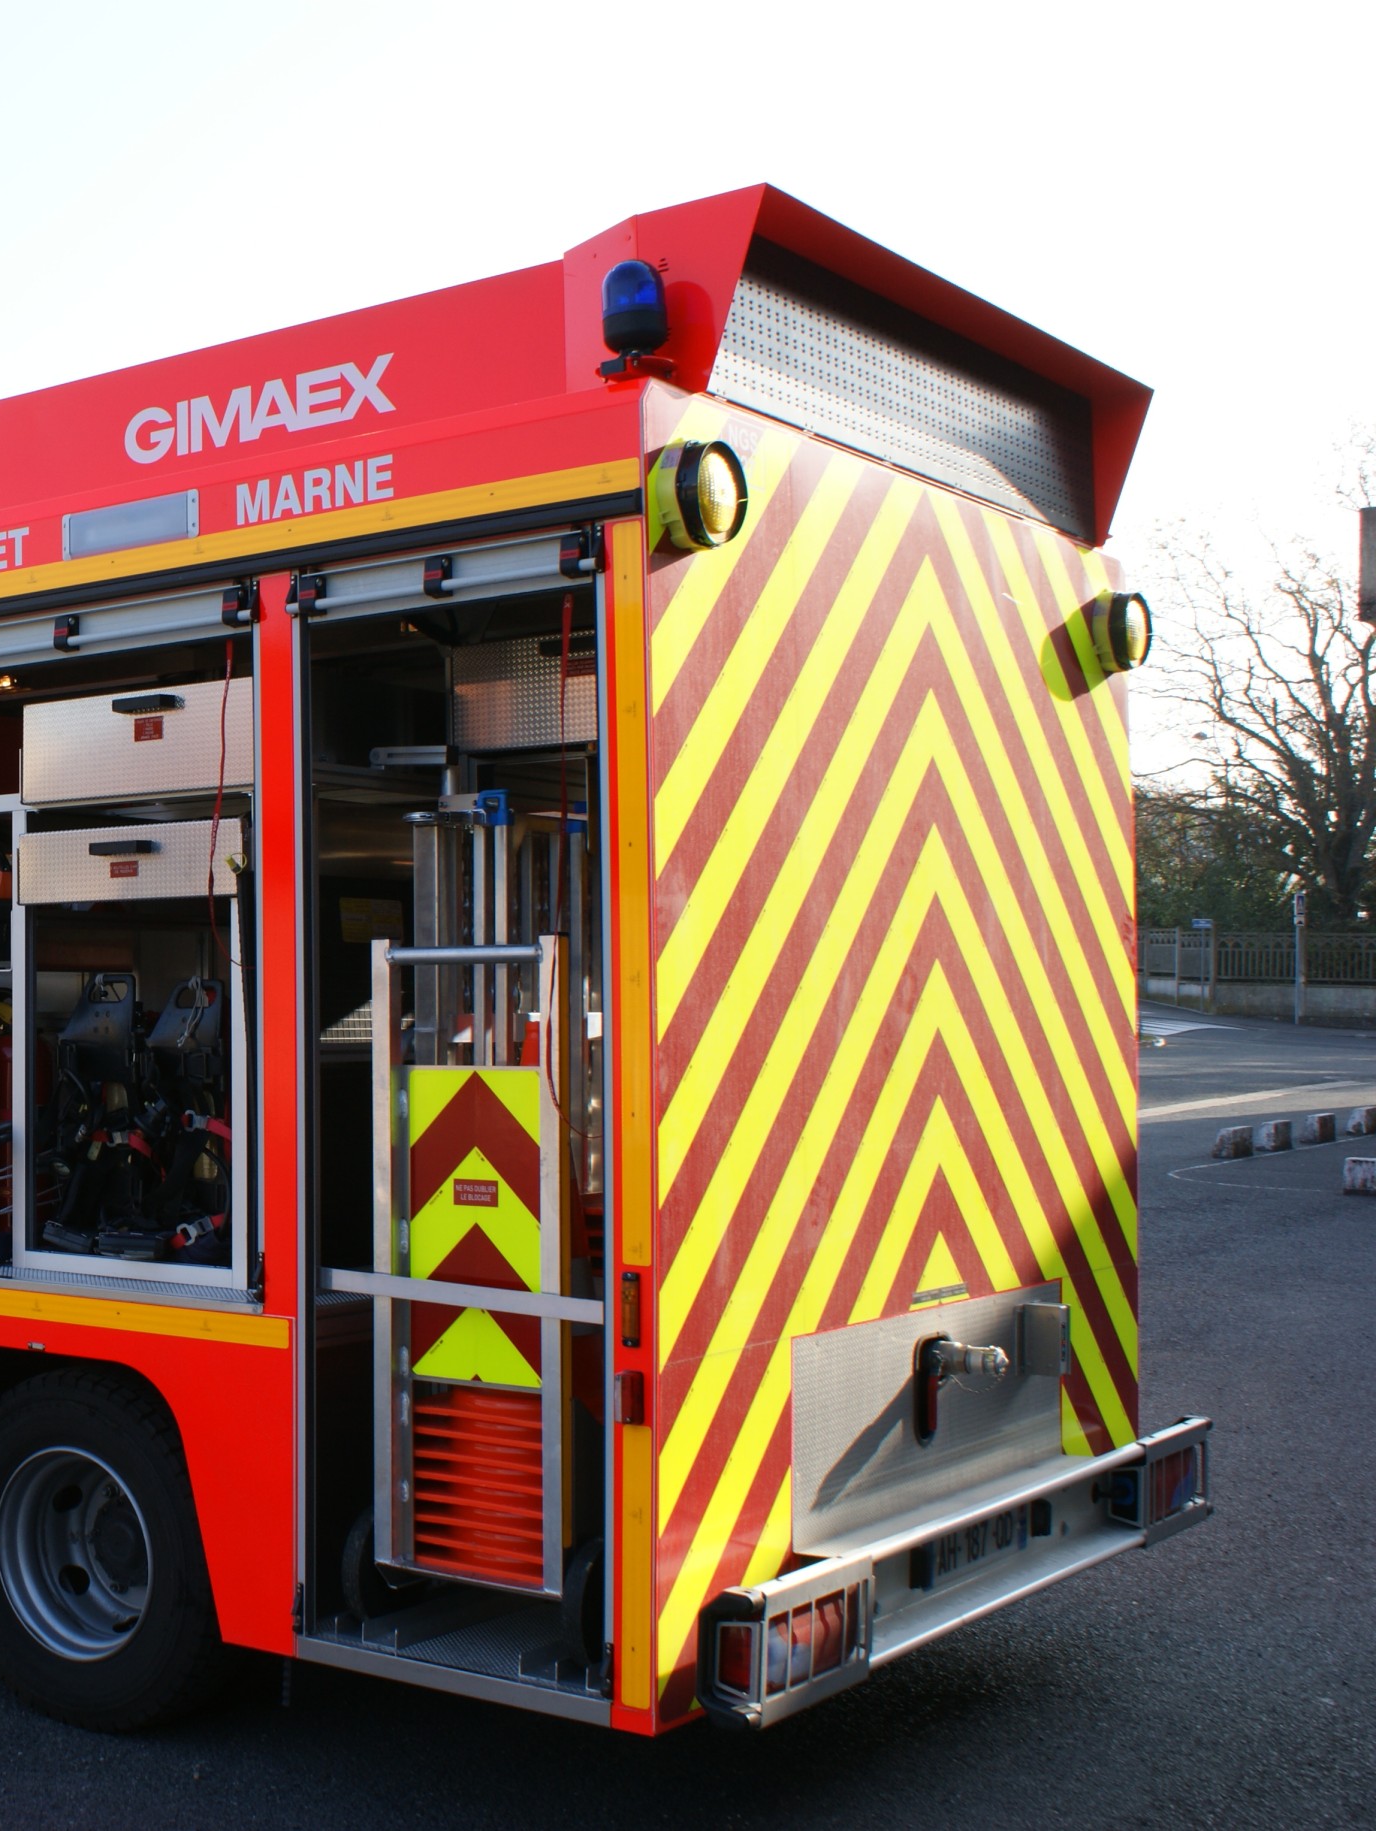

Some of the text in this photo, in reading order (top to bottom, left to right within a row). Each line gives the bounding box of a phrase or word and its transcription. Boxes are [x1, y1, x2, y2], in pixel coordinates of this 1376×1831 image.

[124, 352, 396, 464] GIMAEX
[236, 455, 394, 526] MARNE
[455, 1184, 497, 1194] NE PAS OUBLIER
[460, 1193, 491, 1202] LE BLOCAGE
